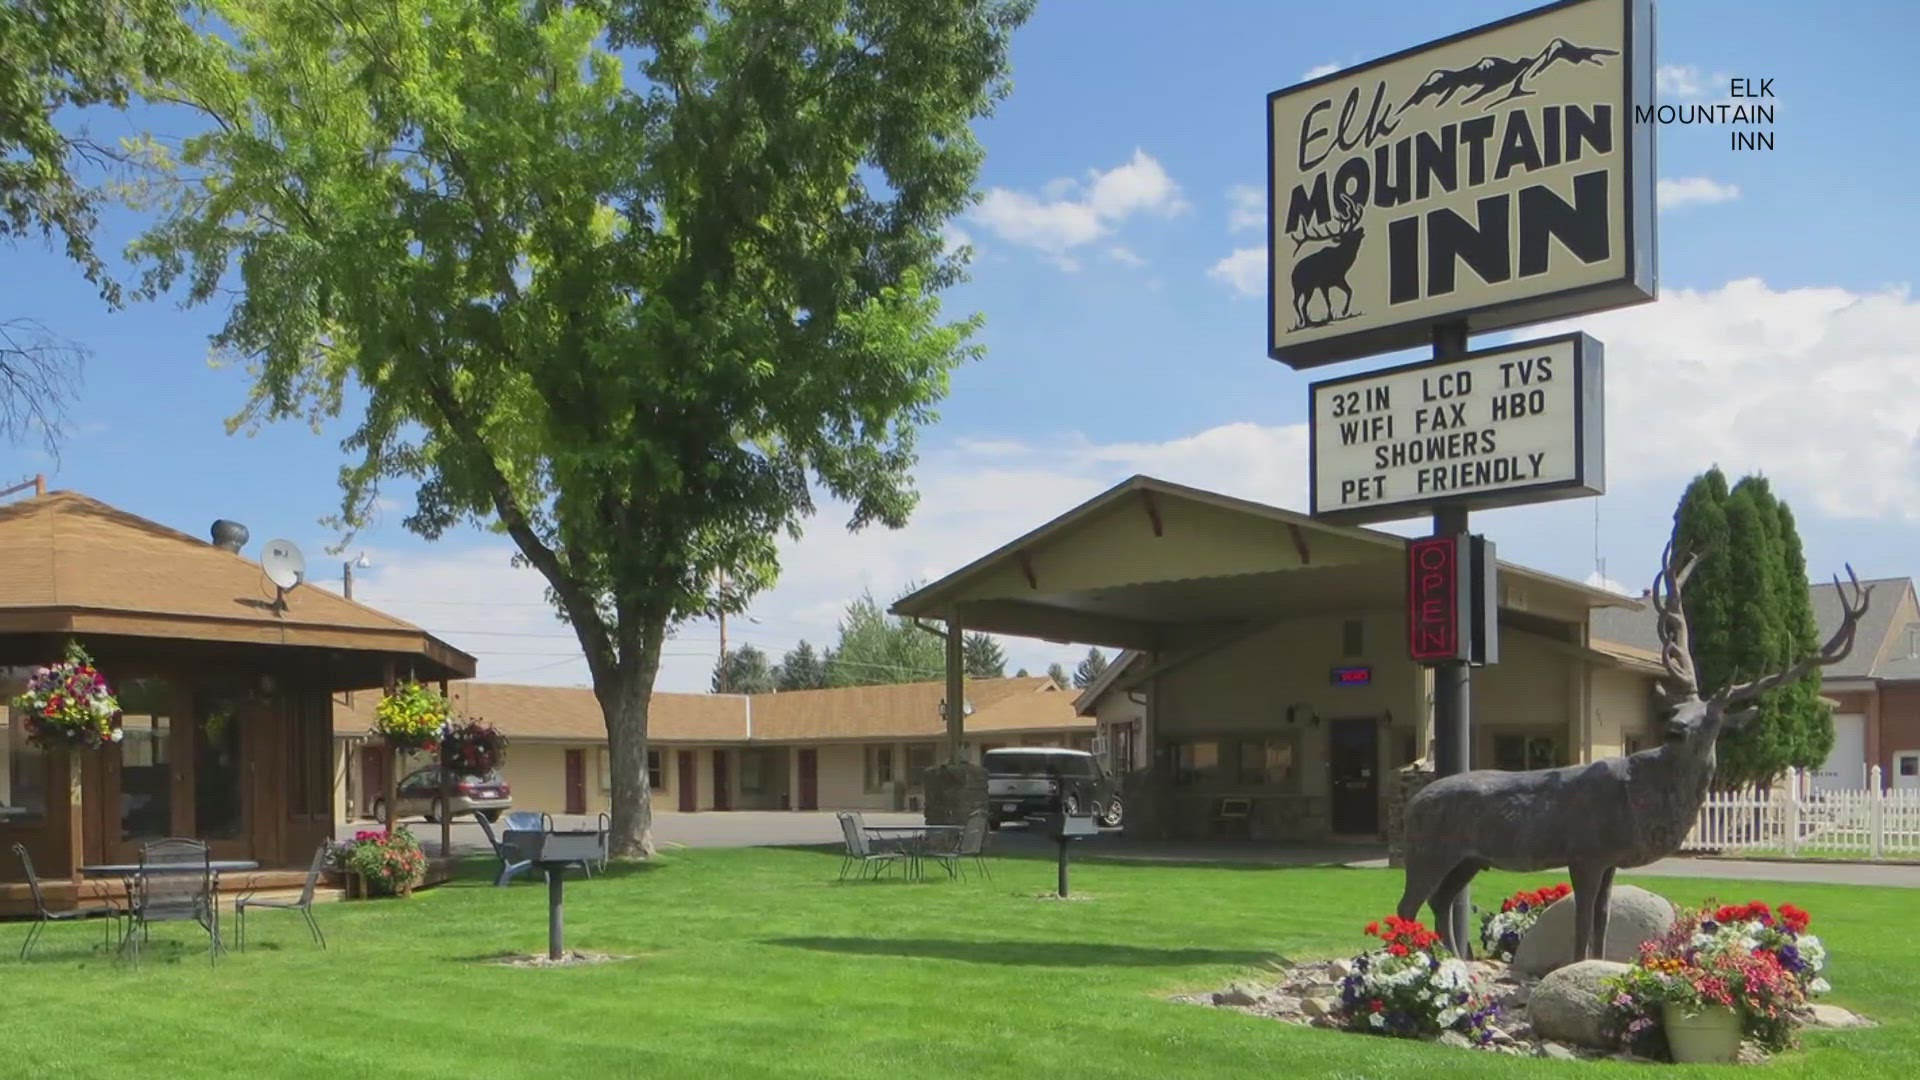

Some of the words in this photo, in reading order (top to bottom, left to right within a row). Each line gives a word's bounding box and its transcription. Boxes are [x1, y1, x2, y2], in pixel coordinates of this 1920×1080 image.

[1299, 80, 1401, 172] Elk
[1285, 104, 1612, 234] MOUNTAIN
[1389, 170, 1609, 306] INN
[1422, 370, 1472, 403] LCD
[1500, 356, 1552, 388] TVS
[1340, 415, 1393, 446] WIFI
[1415, 402, 1467, 434] FAX
[1491, 389, 1545, 421] HBO
[1375, 429, 1496, 470] SHOWERS
[1341, 475, 1387, 504] PET
[1417, 453, 1545, 494] FRIENDLY
[1420, 547, 1446, 651] OPEN
